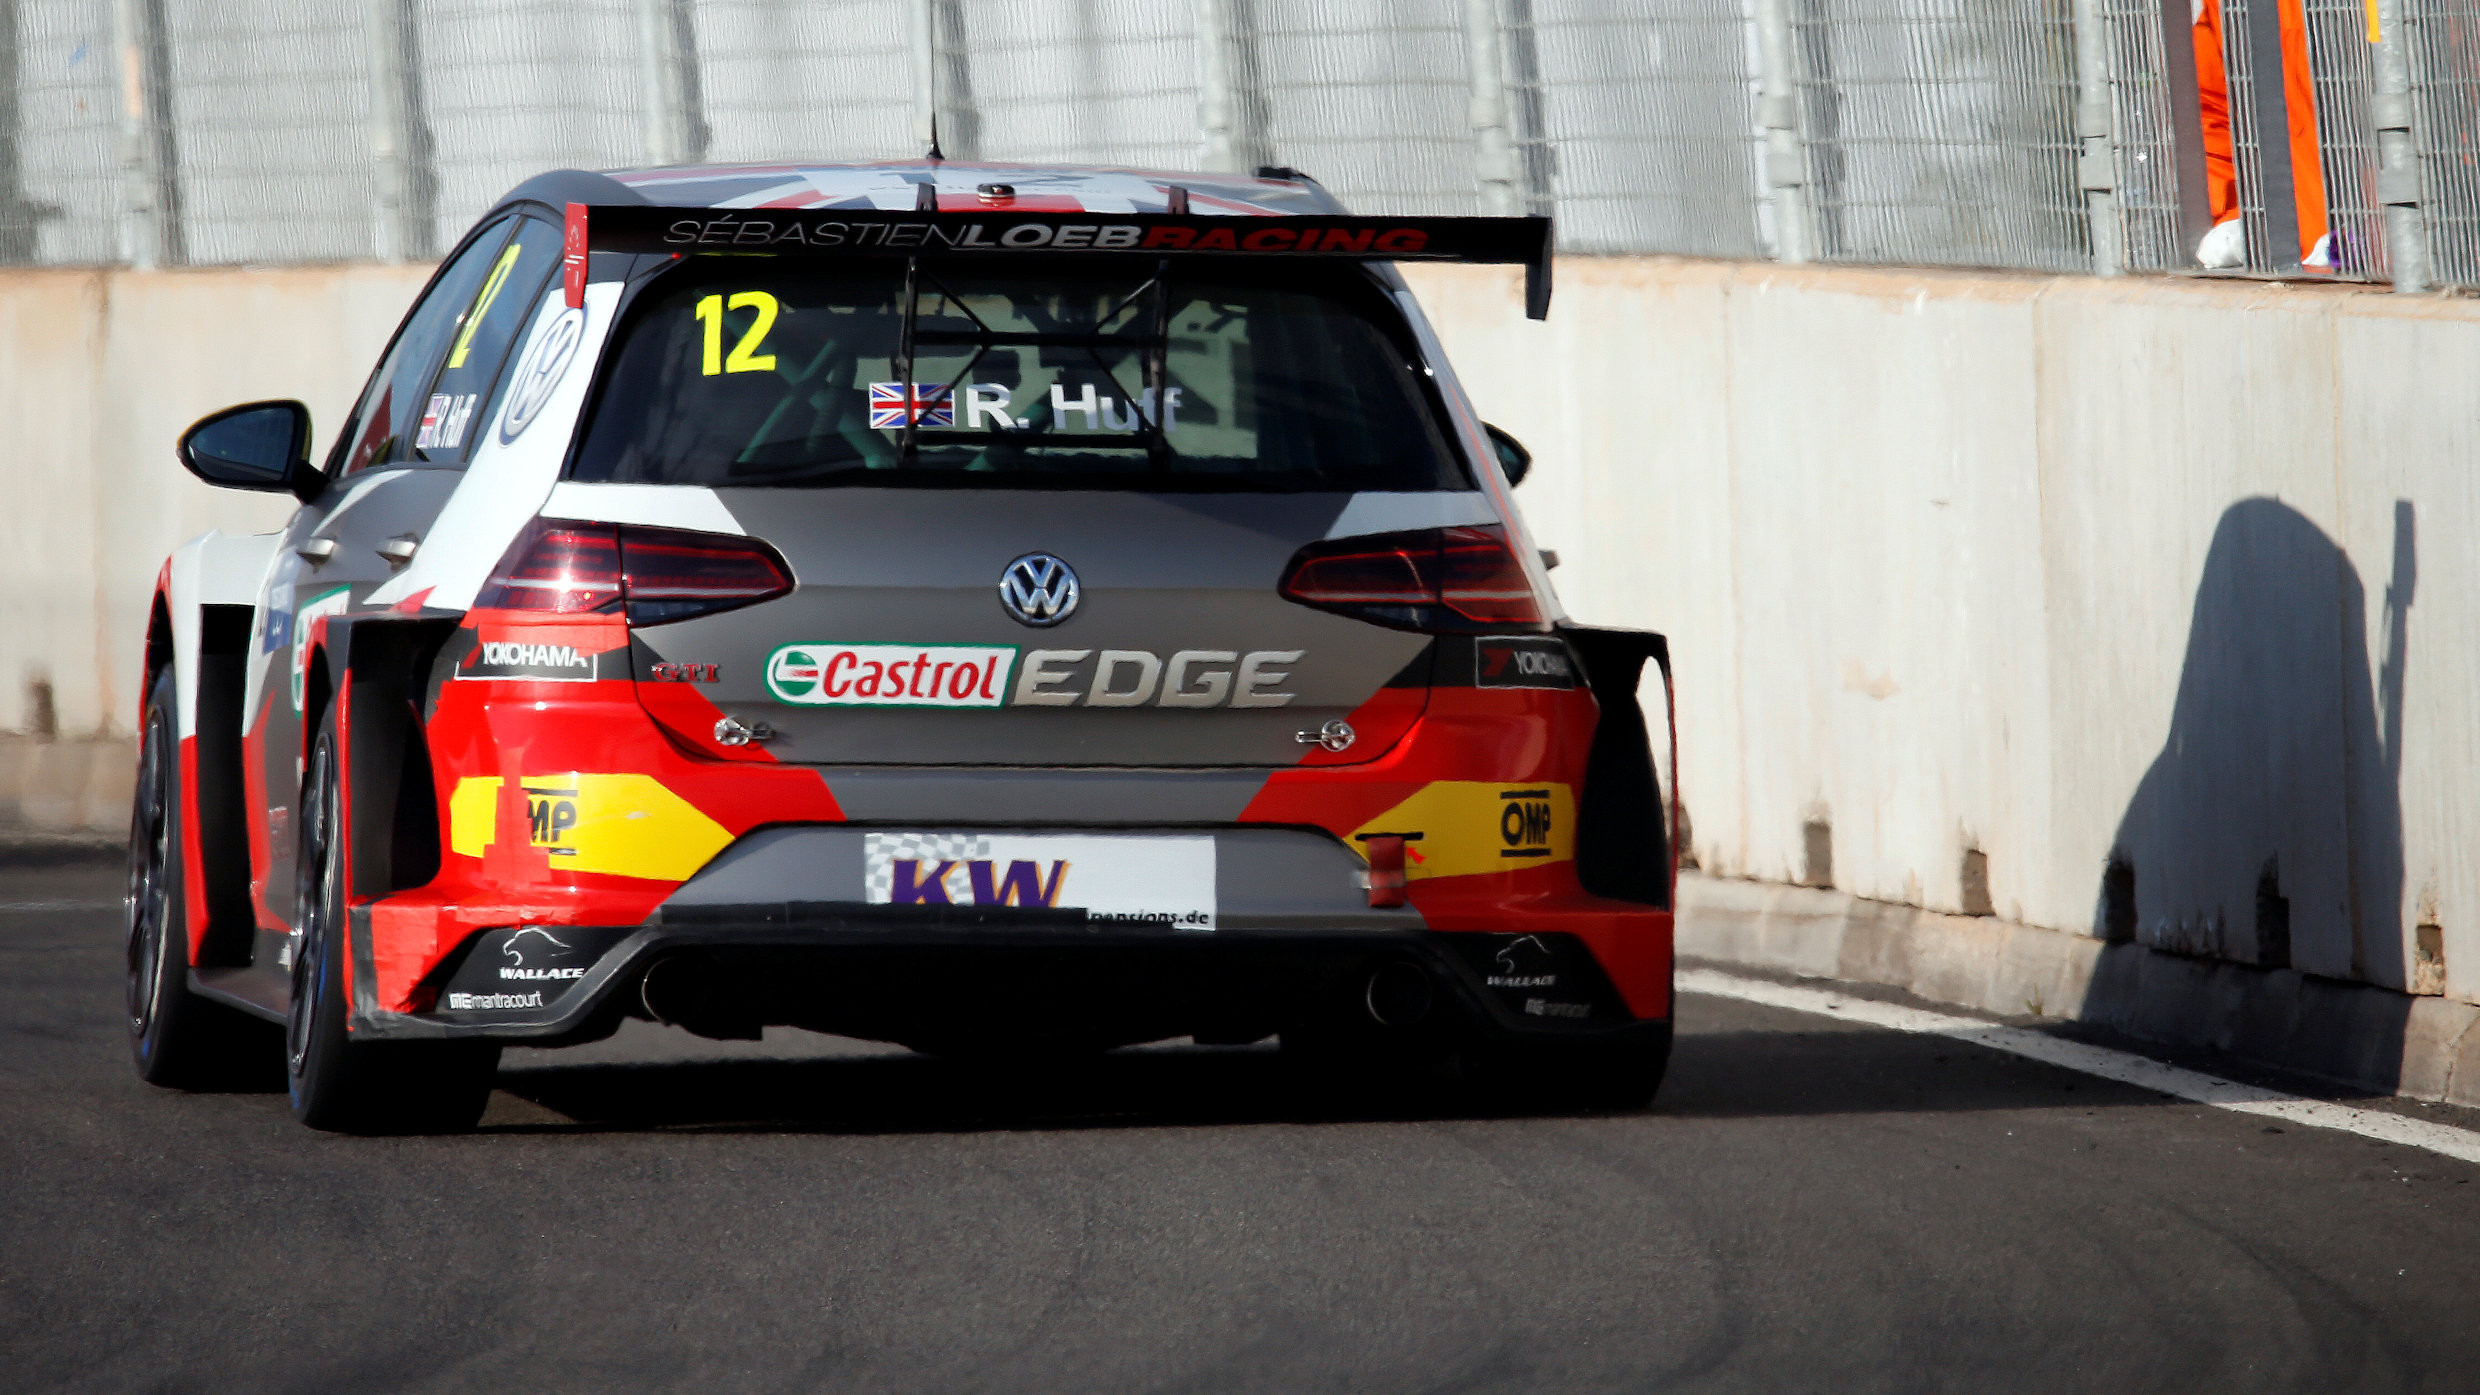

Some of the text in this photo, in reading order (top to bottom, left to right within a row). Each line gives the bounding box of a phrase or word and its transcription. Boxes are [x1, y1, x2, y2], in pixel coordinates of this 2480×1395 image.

[696, 291, 779, 376] 12
[966, 383, 1182, 432] R. Huff
[482, 641, 588, 668] YOKOHAMA
[652, 662, 719, 683] GTI
[823, 649, 1306, 708] Castrol EDGE
[527, 799, 577, 843] MP
[1501, 801, 1552, 846] OMP
[891, 857, 1072, 908] KW
[500, 967, 585, 980] WALLACE
